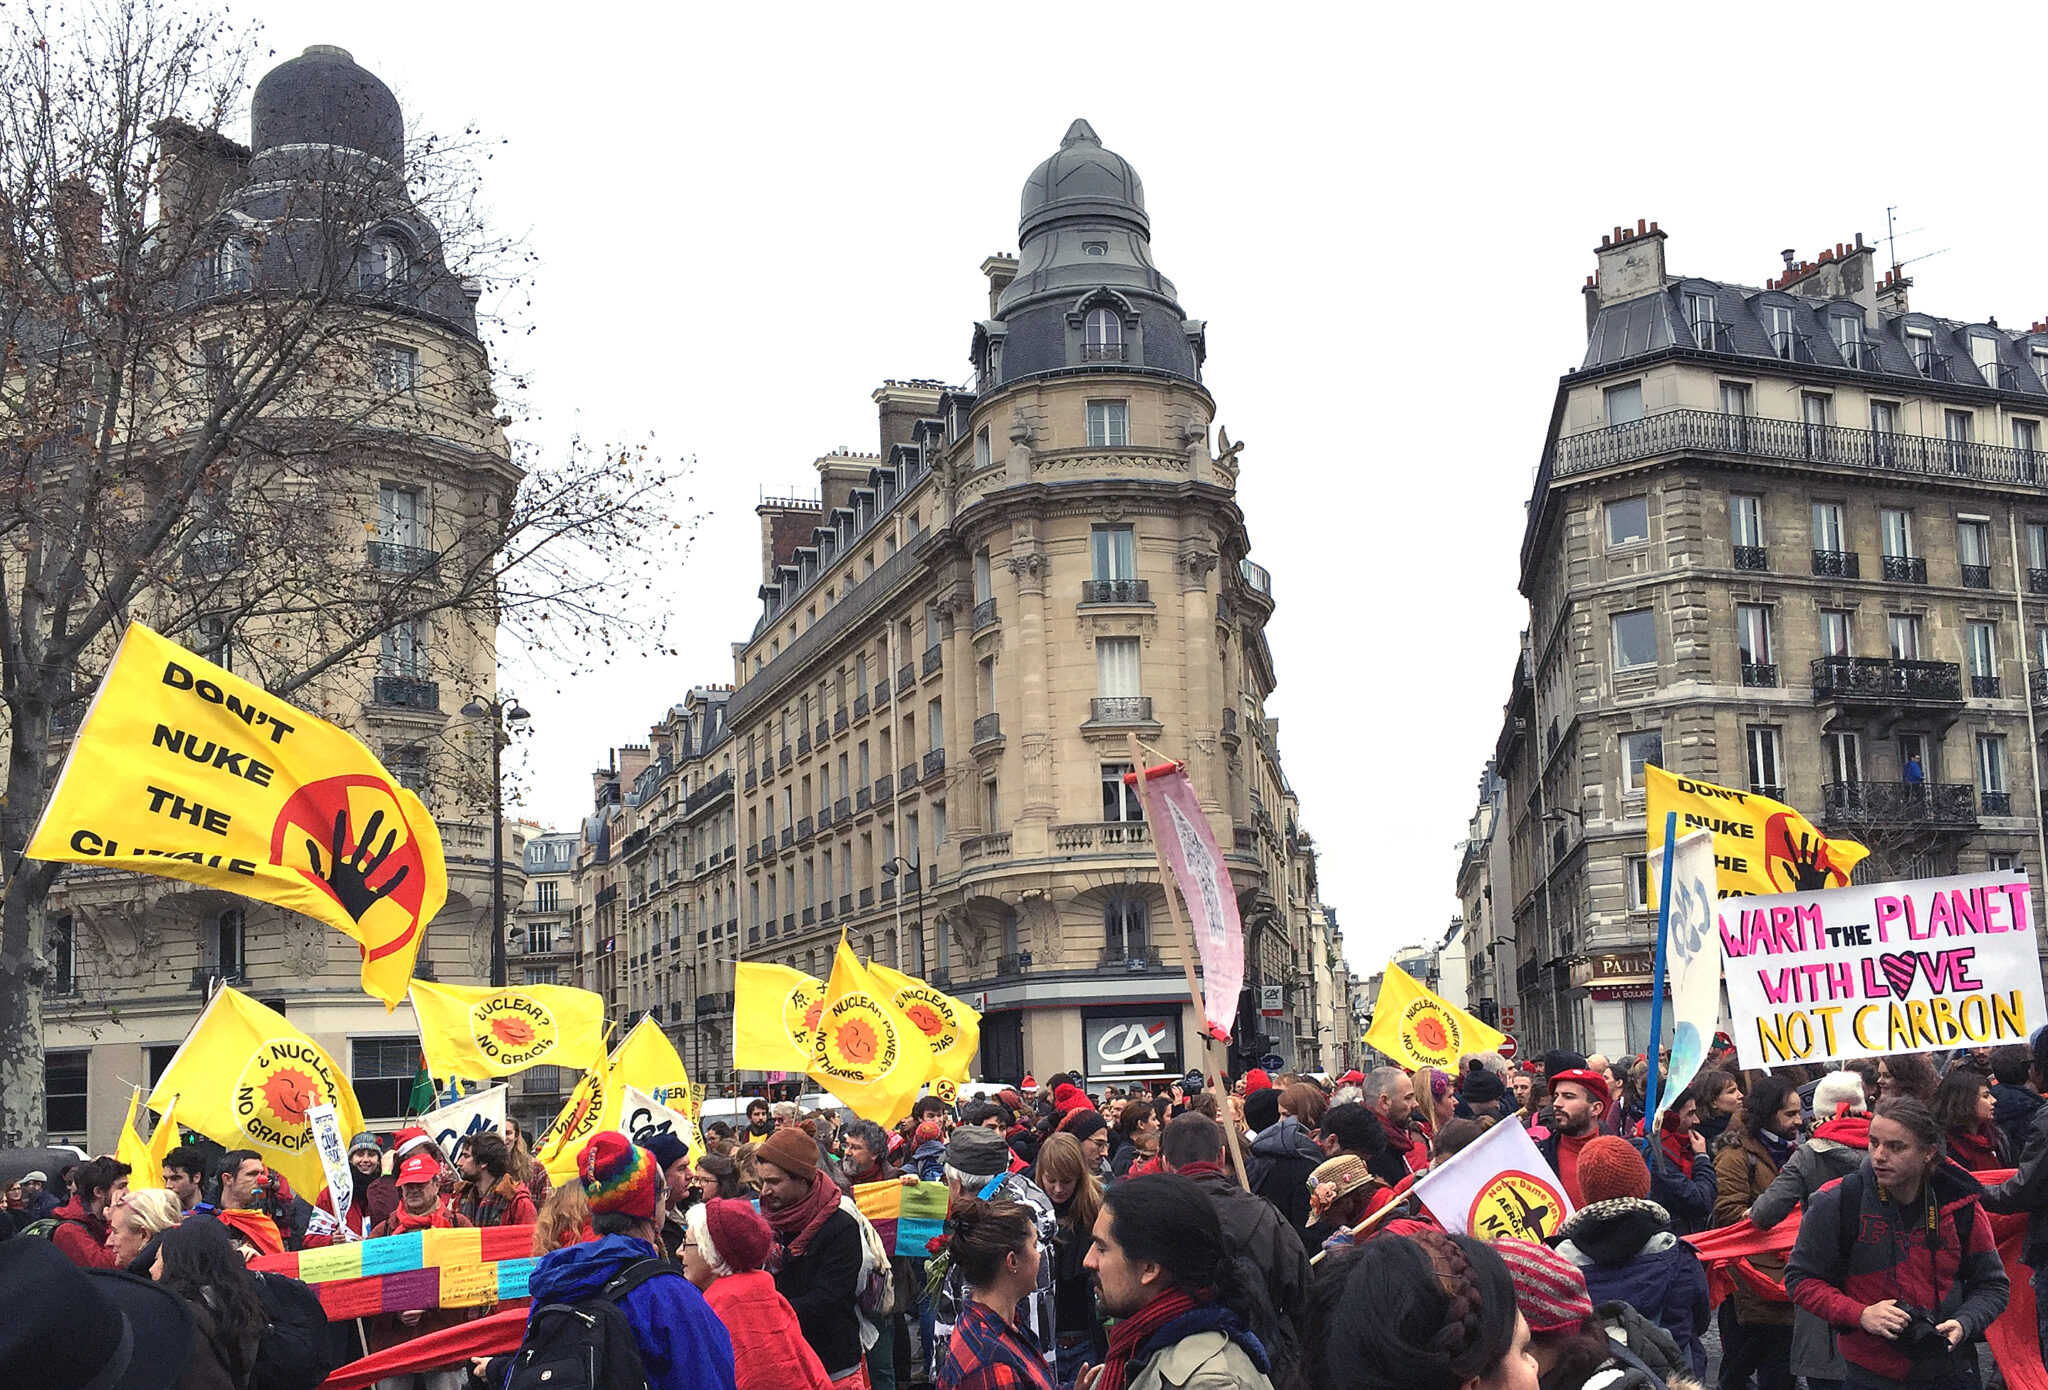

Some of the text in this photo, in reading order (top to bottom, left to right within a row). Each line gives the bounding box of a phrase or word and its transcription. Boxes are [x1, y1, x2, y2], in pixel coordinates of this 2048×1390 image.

[152, 723, 275, 788] NUKE
[147, 785, 232, 836] THE
[1684, 813, 1755, 839] NUKE
[1714, 854, 1748, 873] HE
[1718, 882, 2031, 957] WARM THE PLANET
[1602, 959, 1656, 974] PATIS
[1758, 961, 1855, 1004] WITH
[832, 995, 882, 1019] NUCLEAR
[1405, 999, 1441, 1021] NUCLEAR
[1756, 989, 2028, 1064] NOT CARBON
[477, 1034, 499, 1057] NO
[815, 1030, 865, 1081] NO THANKS
[1402, 1034, 1448, 1066] NO THANKS
[238, 1086, 315, 1151] NO GRACIAS
[1519, 1180, 1547, 1201] Dame
